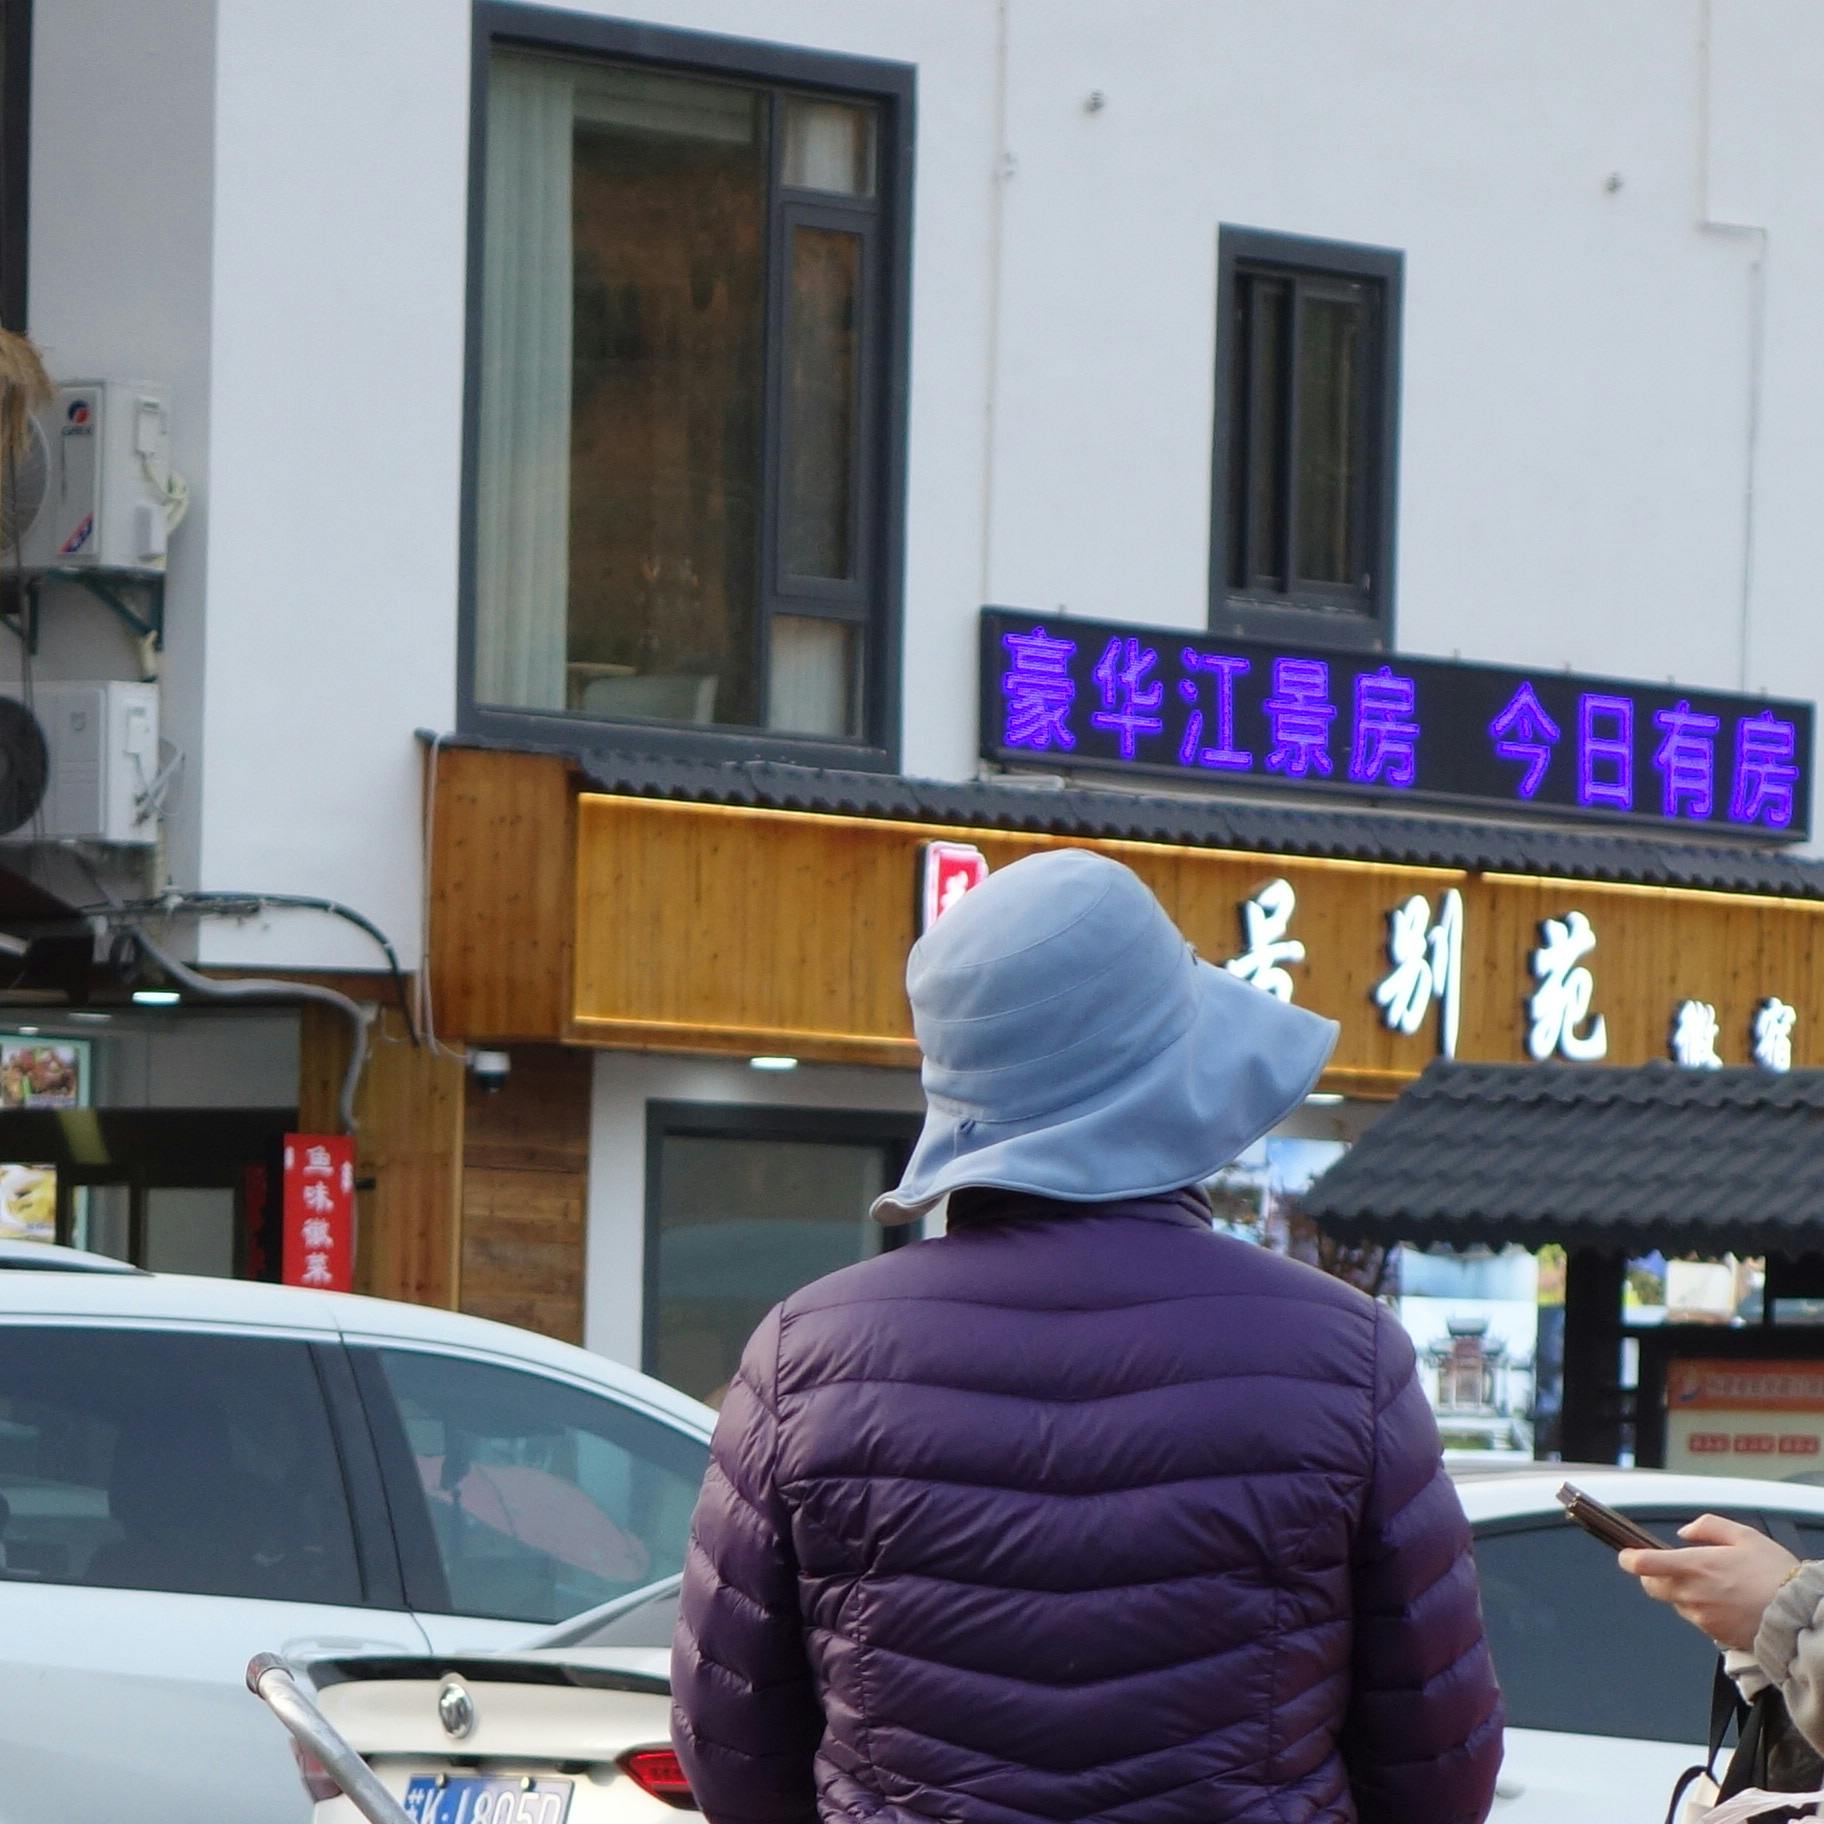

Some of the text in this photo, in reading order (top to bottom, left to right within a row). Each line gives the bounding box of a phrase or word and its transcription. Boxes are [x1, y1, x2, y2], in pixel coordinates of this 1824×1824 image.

[1003, 626, 1800, 829] 豪华江景房 今日有房
